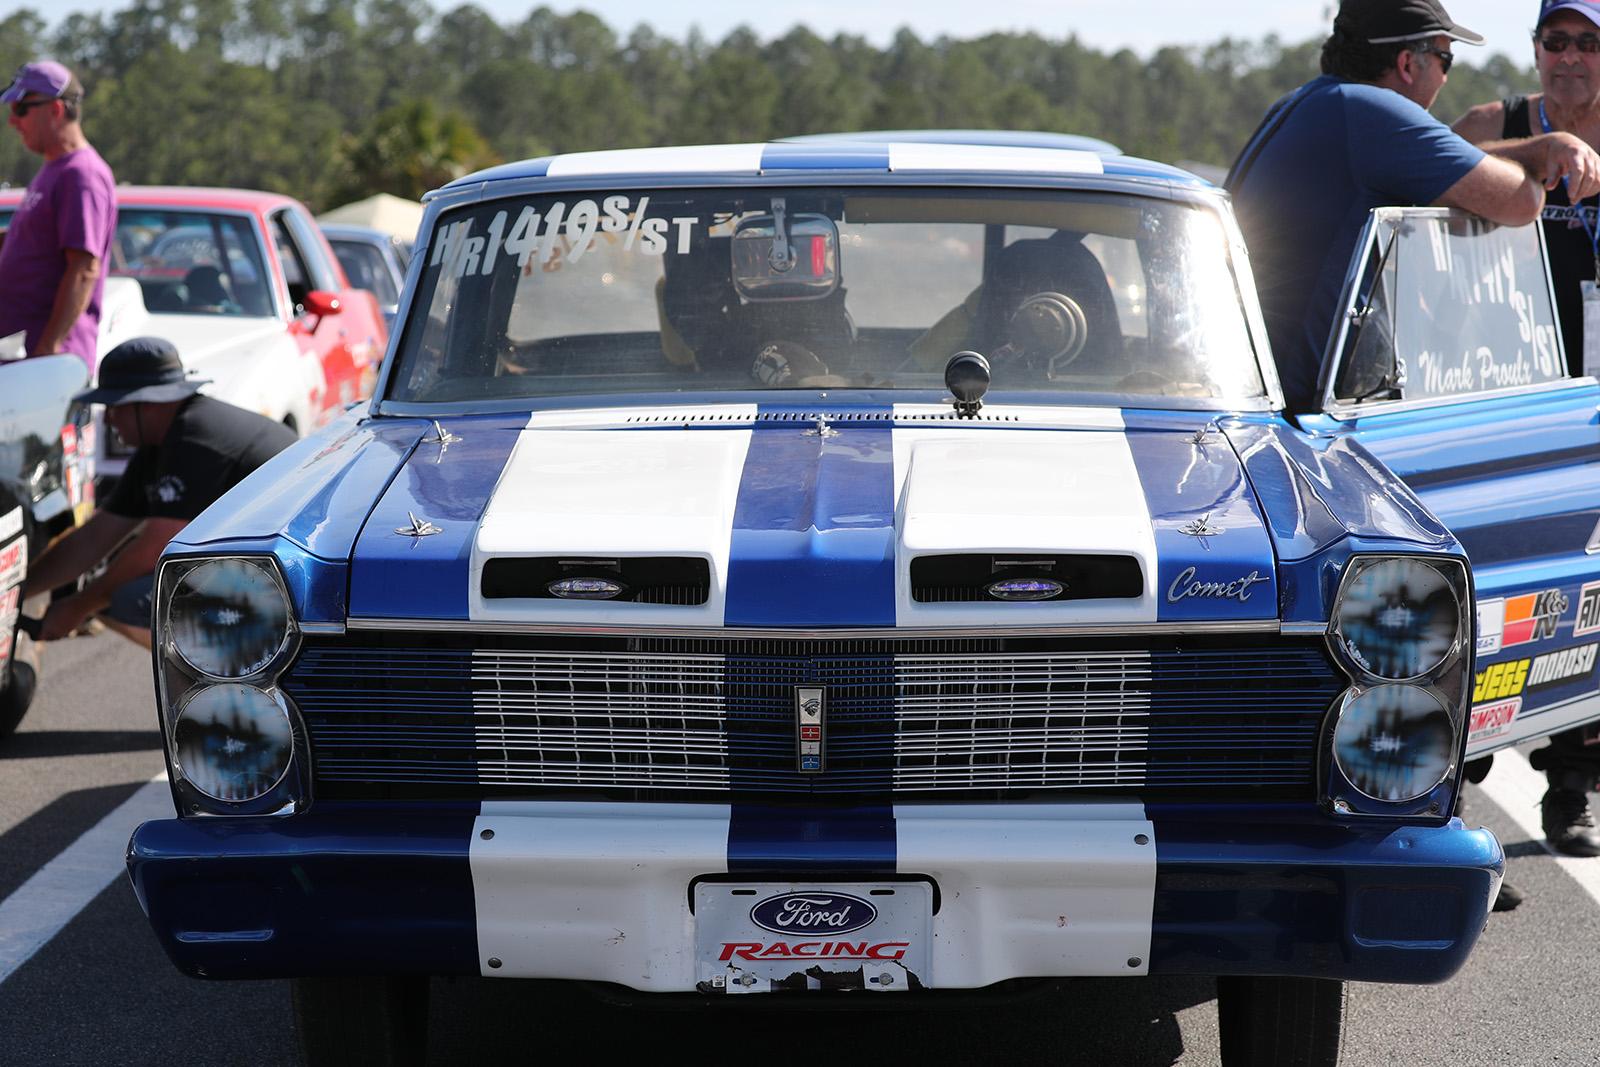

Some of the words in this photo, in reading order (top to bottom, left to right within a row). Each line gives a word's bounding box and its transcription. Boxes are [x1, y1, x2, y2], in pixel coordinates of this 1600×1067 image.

[1418, 350, 1474, 393] Mark
[1167, 566, 1270, 602] Comet
[1472, 659, 1531, 703] JEGS
[1527, 642, 1599, 687] MOROSO
[776, 898, 851, 927] Ford
[719, 942, 910, 961] RACING
